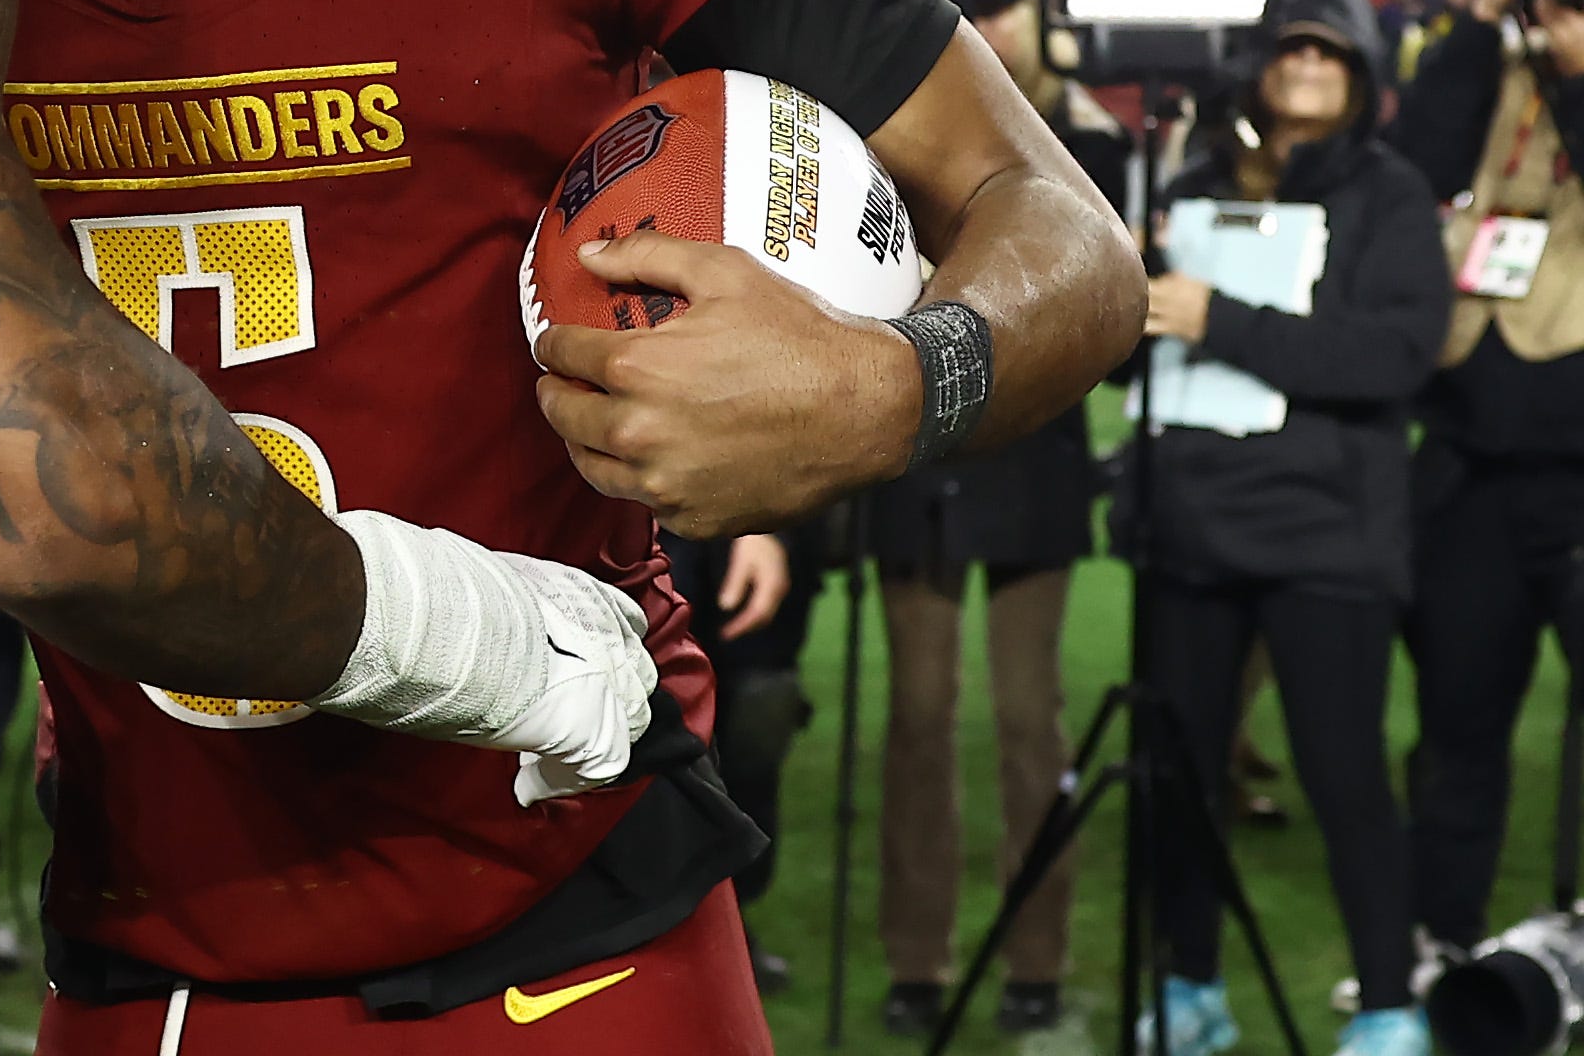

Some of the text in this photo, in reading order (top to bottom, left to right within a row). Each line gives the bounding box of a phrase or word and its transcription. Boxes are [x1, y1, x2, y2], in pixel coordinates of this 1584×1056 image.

[2, 83, 405, 173] OMMANDERS
[770, 101, 794, 159] NIGHT
[797, 124, 820, 154] OF
[764, 157, 793, 262] SUNDAY
[793, 154, 820, 250] PLAYER
